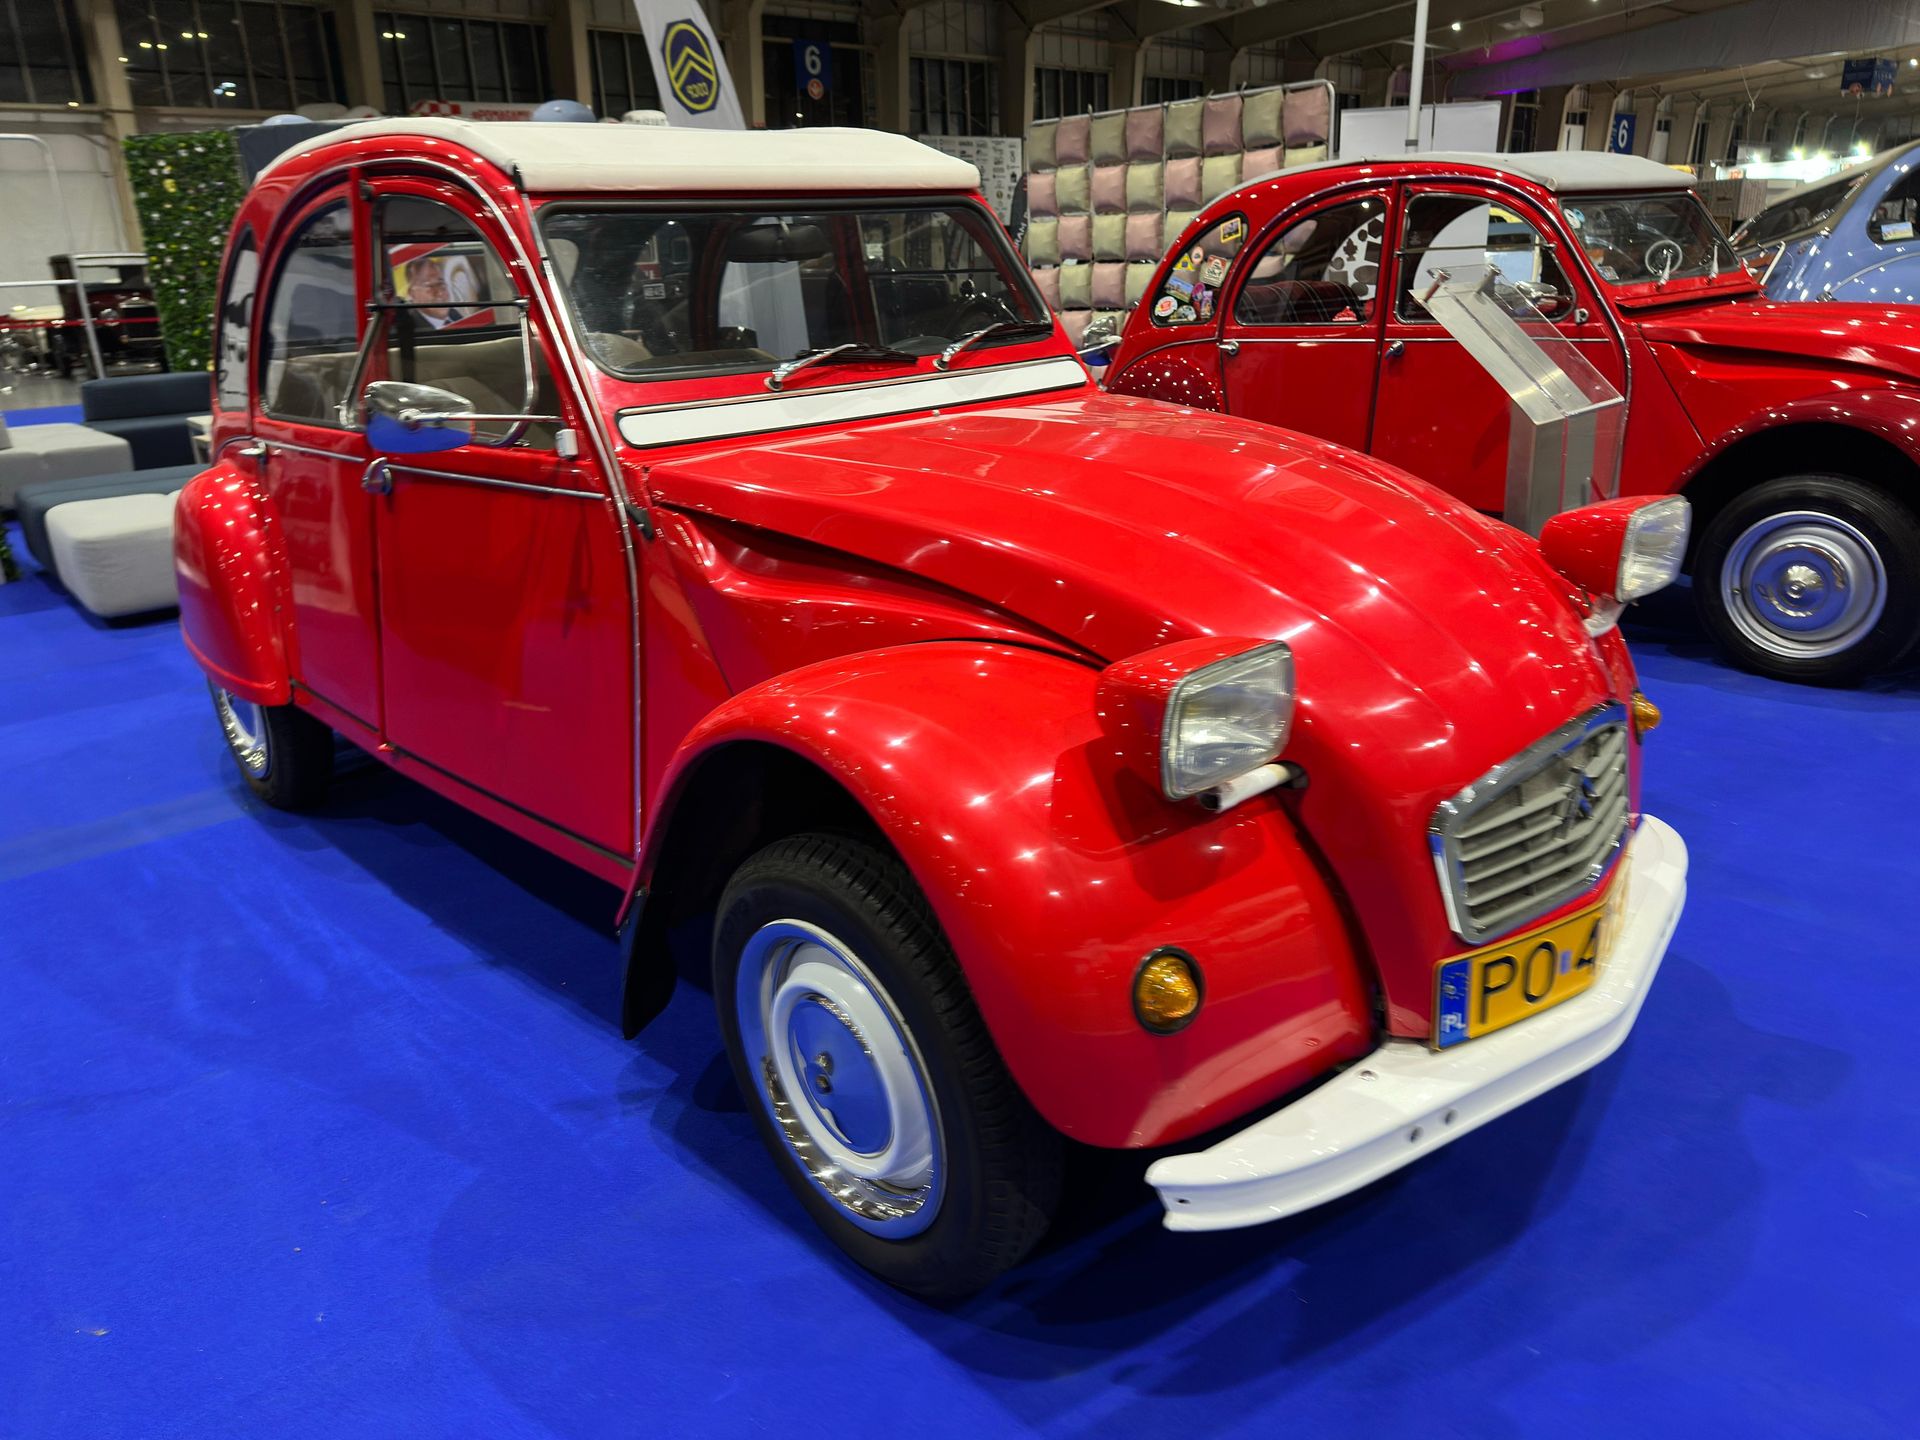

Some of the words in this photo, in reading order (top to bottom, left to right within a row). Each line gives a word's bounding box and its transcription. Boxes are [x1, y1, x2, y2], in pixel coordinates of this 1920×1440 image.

[805, 45, 821, 75] 6
[1618, 119, 1629, 149] 6
[1441, 1011, 1467, 1033] PL
